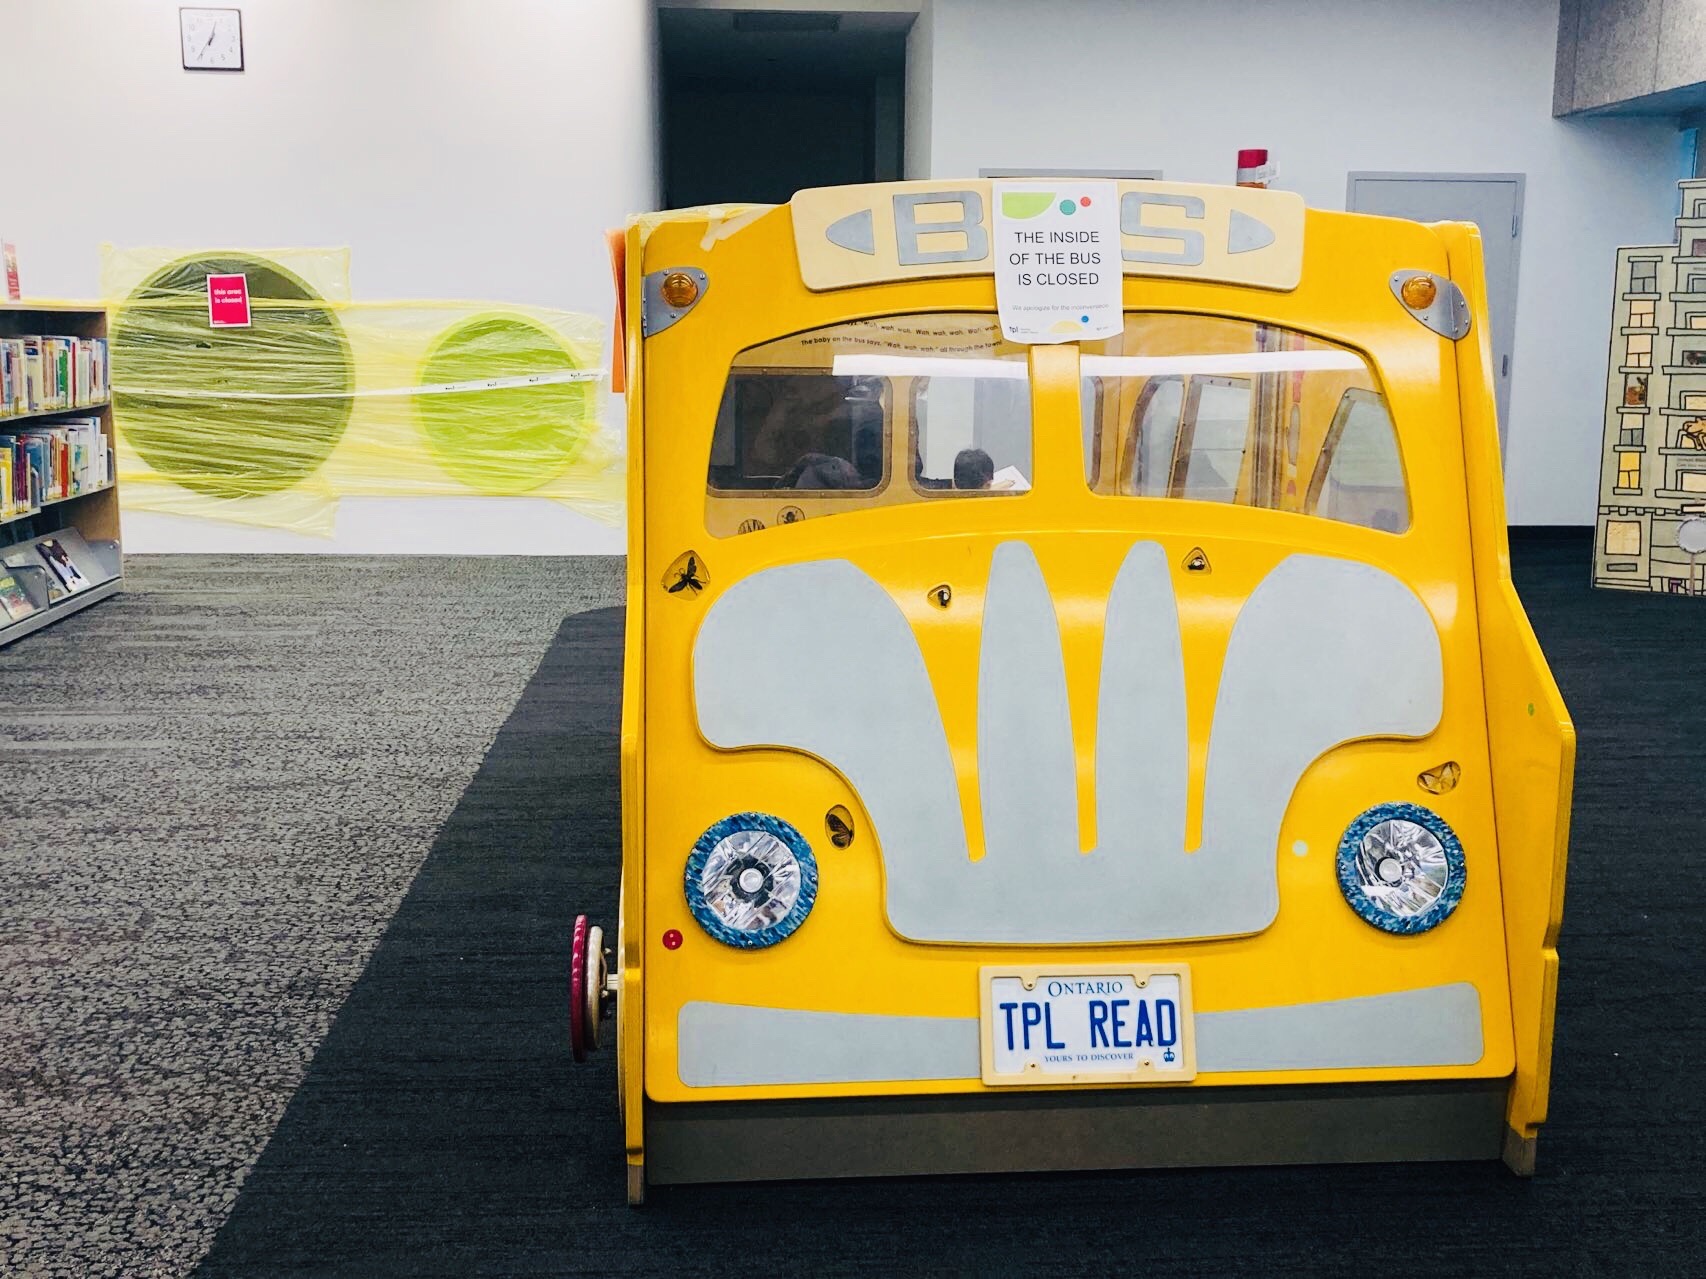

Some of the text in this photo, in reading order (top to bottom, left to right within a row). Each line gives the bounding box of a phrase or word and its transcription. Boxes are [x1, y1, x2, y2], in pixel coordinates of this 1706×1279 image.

[1014, 231, 1100, 243] THE INSIDE
[1009, 252, 1101, 265] OF THE BUS
[1018, 273, 1099, 286] IS CLOSED
[1048, 981, 1123, 997] ONTARIO
[1000, 999, 1177, 1050] TPL READ
[1044, 1052, 1134, 1062] YOURS TO DISCOVER
